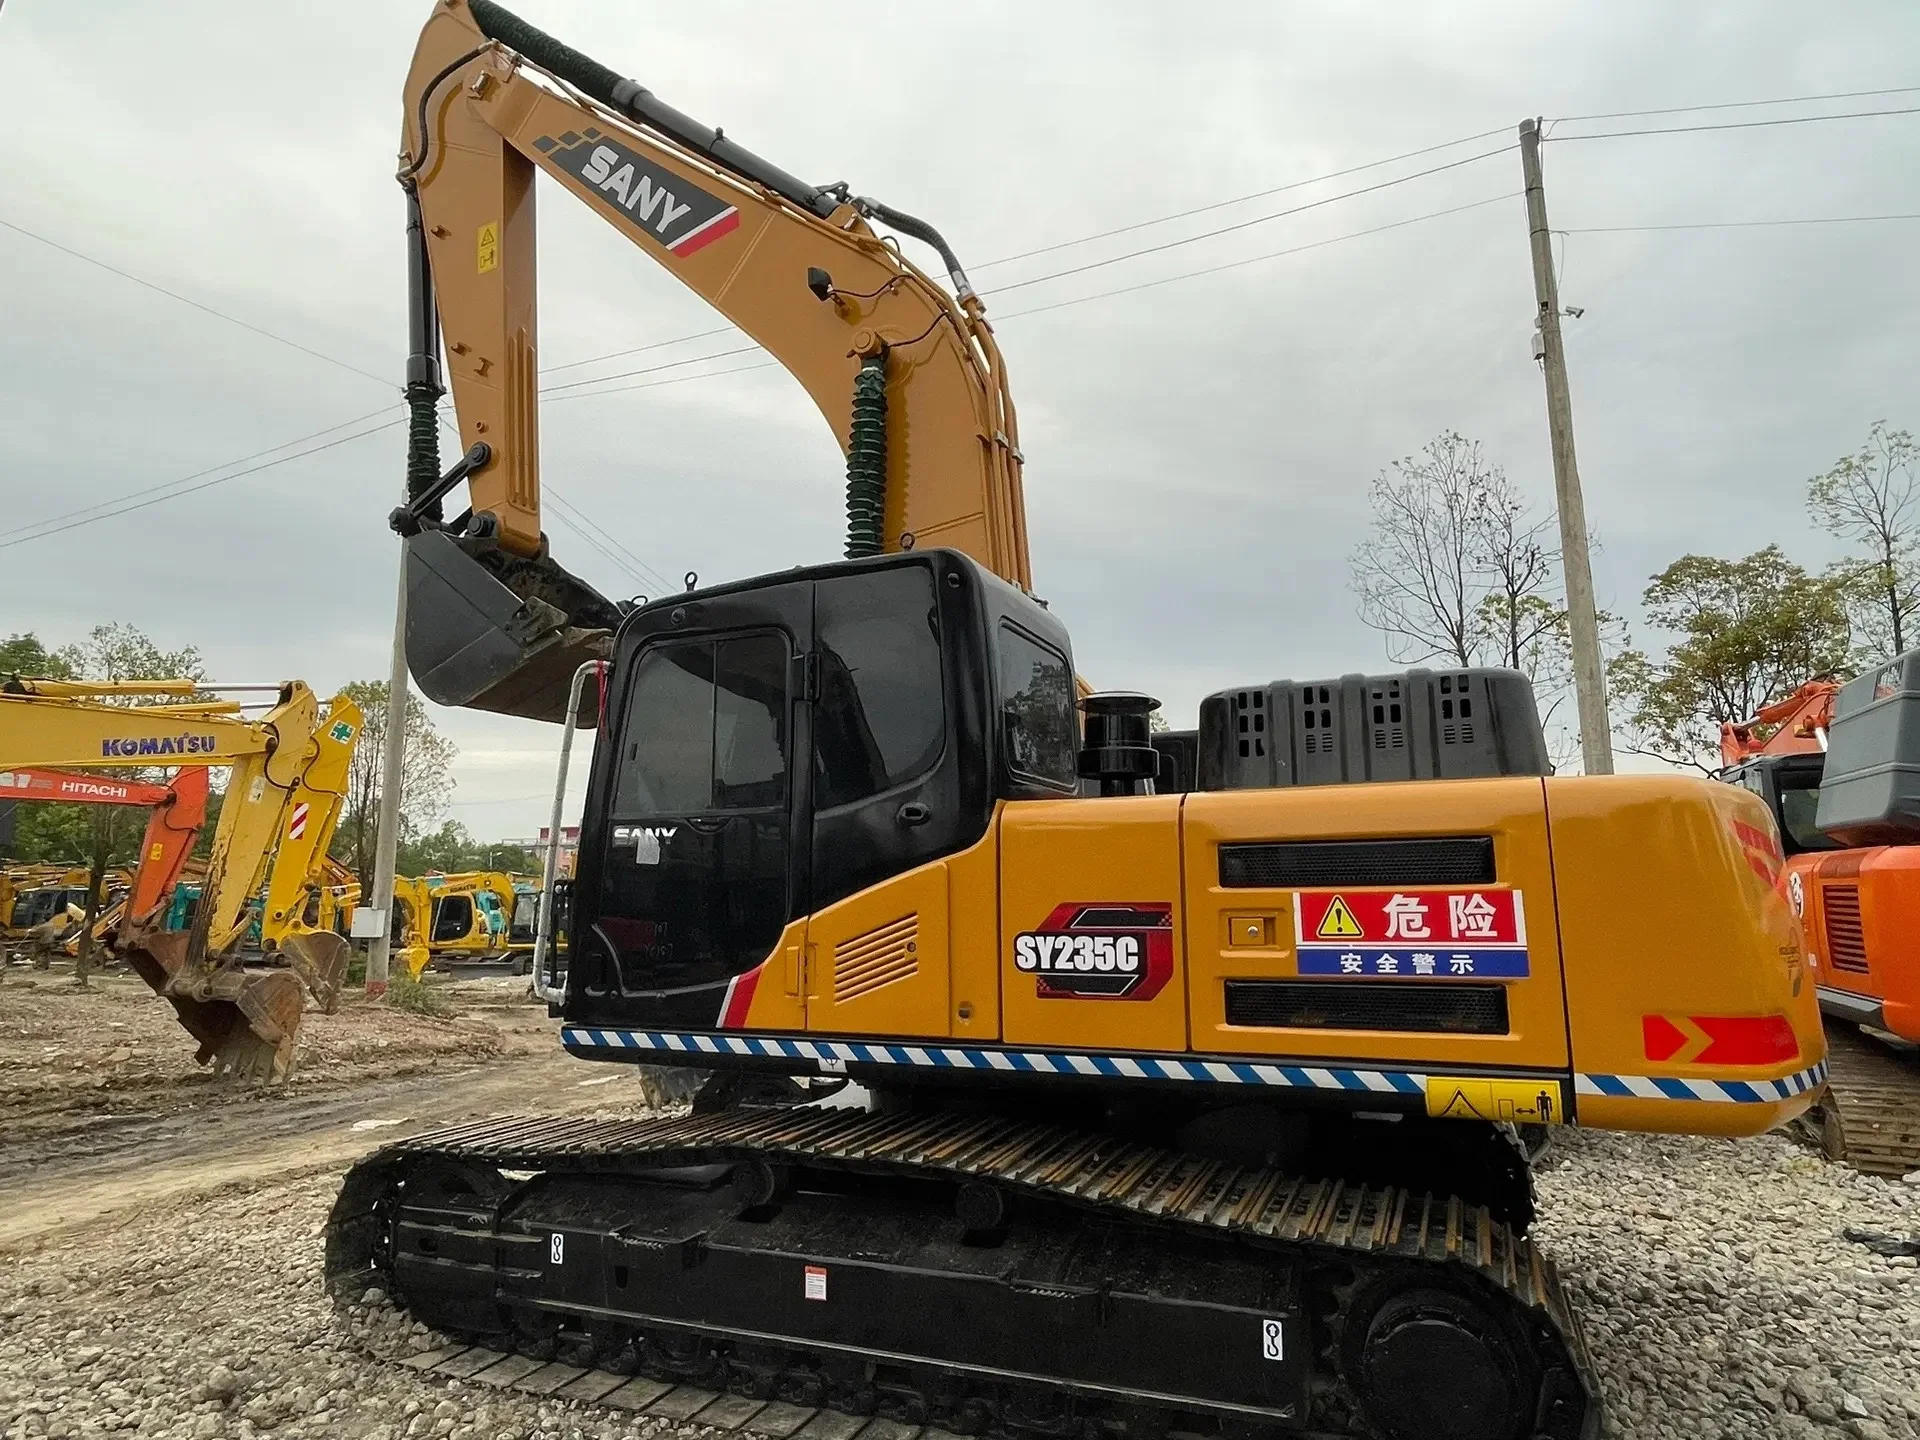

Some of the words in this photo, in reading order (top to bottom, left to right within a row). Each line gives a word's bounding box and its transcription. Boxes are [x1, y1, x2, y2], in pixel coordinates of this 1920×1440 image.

[580, 145, 692, 233] SANY
[102, 734, 215, 757] KOMATSU
[61, 780, 128, 798] HITACHI
[1382, 893, 1498, 939] 危险
[1016, 935, 1139, 972] SY235C
[1340, 952, 1475, 975] 安全警示
